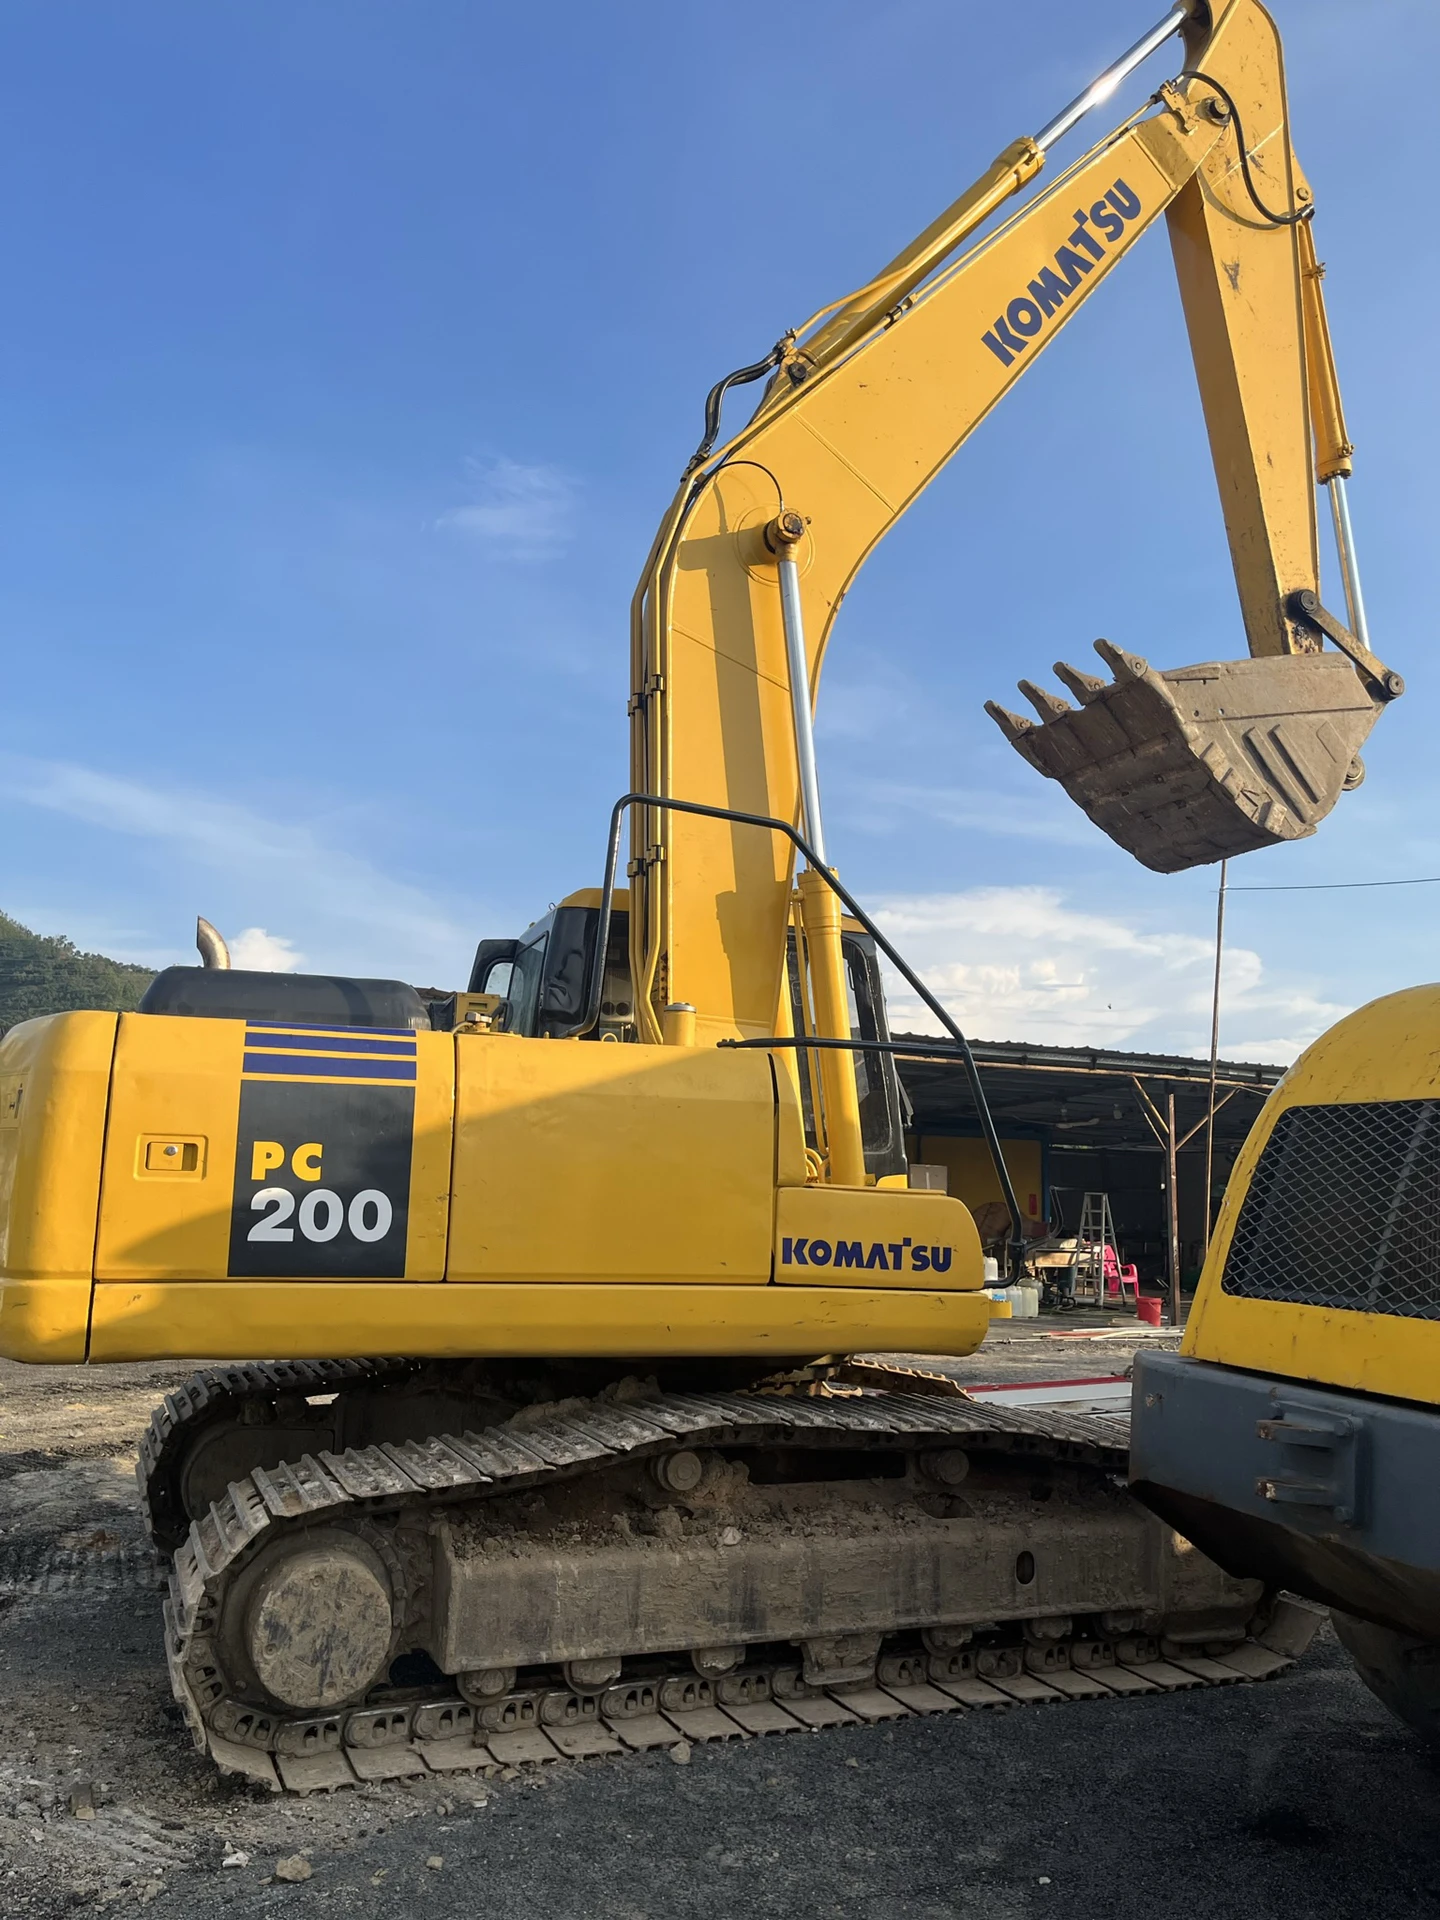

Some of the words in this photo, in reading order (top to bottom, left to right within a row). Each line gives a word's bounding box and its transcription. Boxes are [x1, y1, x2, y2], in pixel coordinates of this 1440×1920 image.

[980, 178, 1142, 368] KOMATSU
[251, 1141, 323, 1182] PC
[247, 1187, 393, 1243] 200
[782, 1237, 952, 1273] KOMATSU
